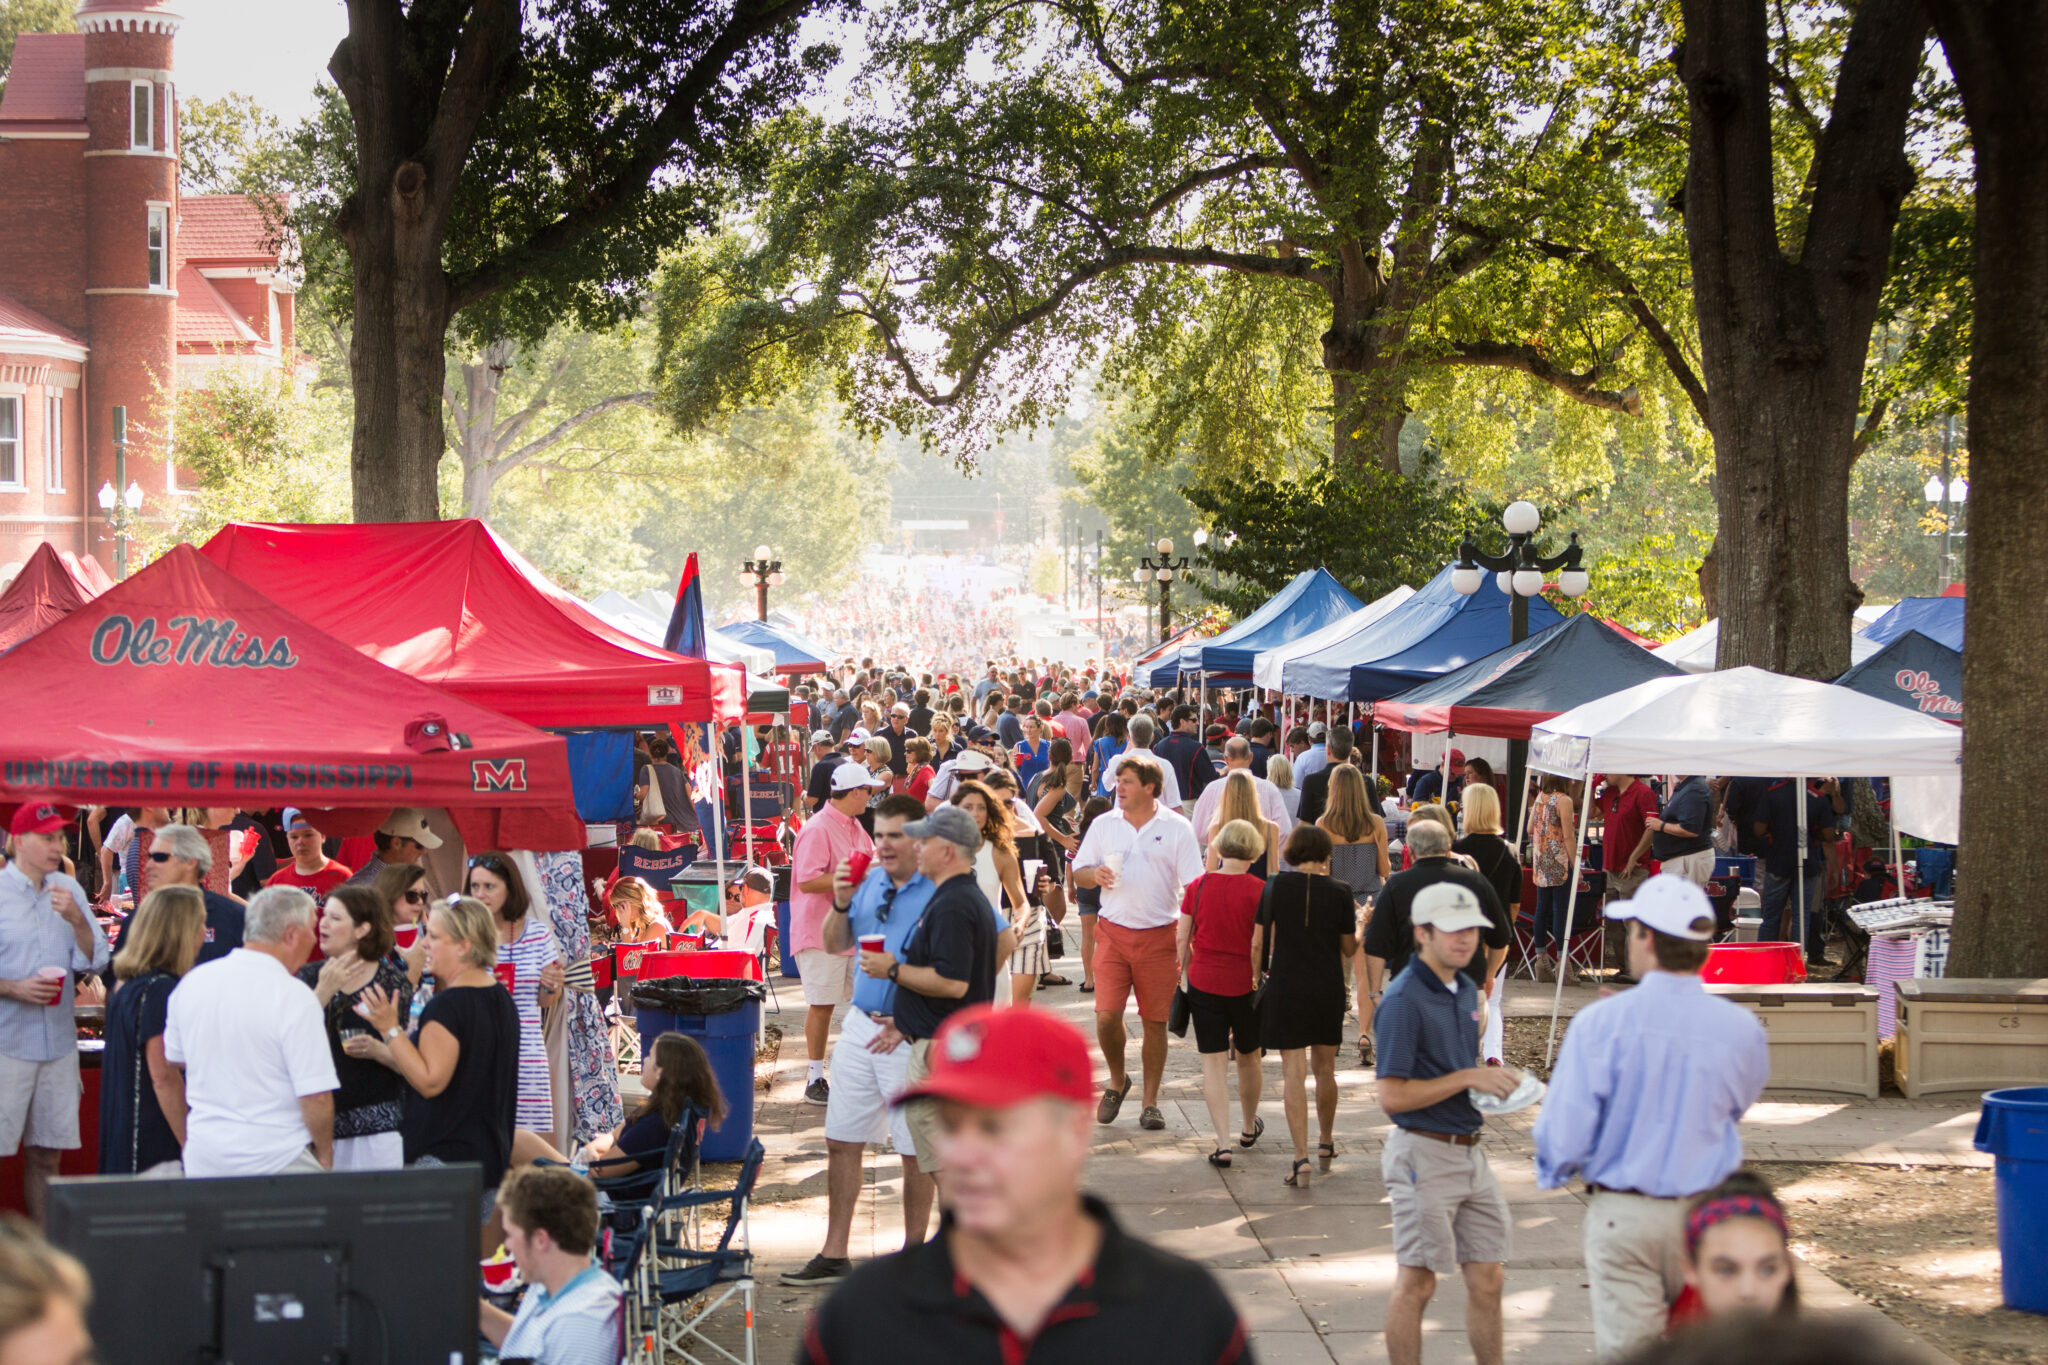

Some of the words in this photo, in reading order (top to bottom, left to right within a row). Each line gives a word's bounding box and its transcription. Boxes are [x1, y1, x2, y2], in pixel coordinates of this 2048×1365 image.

[91, 615, 170, 665] Ole
[168, 616, 299, 668] Miss
[1895, 669, 1940, 693] Ole
[5, 761, 174, 788] UNIVERSITY
[187, 762, 221, 789] OF
[234, 762, 412, 789] MISSISSIPPI
[471, 758, 527, 792] M
[634, 855, 683, 870] REBELS
